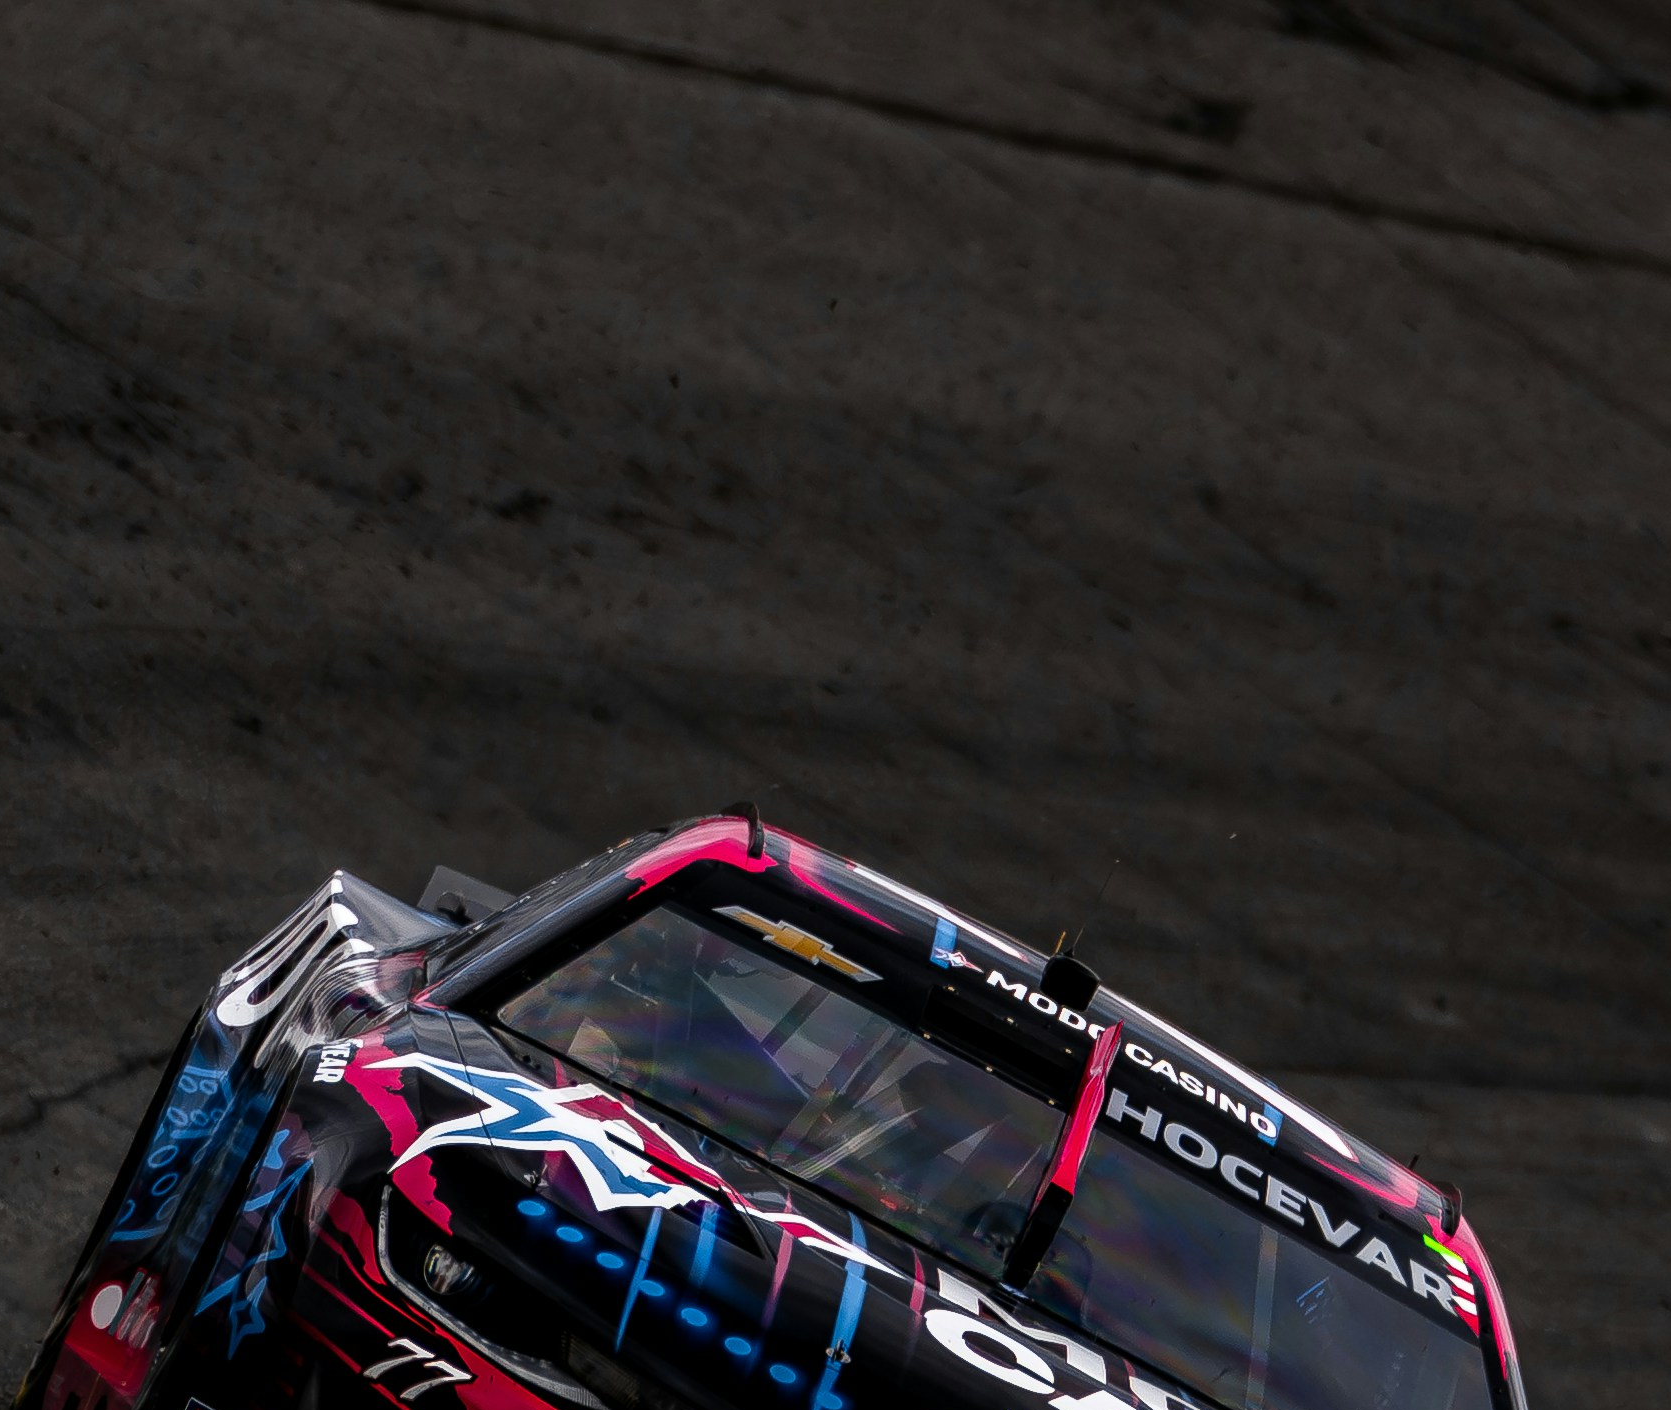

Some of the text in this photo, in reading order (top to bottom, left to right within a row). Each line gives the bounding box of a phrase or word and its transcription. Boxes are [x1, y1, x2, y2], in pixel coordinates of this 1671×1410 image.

[1125, 1043, 1278, 1139] CASINO
[1105, 1087, 1458, 1318] HOCEVAR
[363, 1338, 473, 1401] 77
